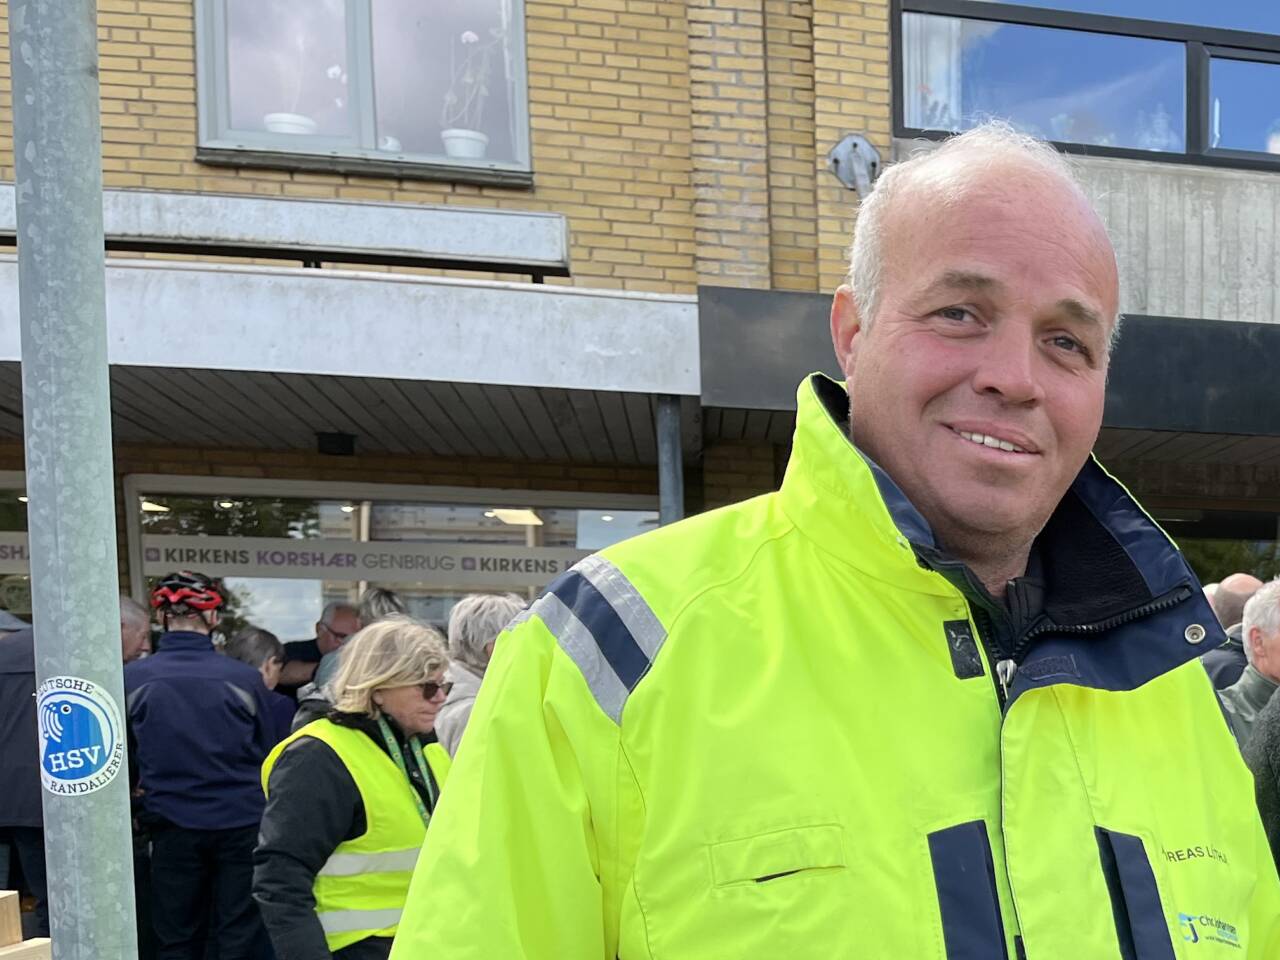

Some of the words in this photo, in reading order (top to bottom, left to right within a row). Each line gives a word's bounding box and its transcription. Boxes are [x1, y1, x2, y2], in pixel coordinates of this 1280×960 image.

[165, 548, 249, 564] KIRKENS
[257, 551, 357, 568] KORSHÆR
[362, 553, 455, 571] GENBRUG
[480, 557, 558, 573] KIRKENS
[48, 745, 101, 772] HSV
[50, 742, 123, 794] RANDALIERER
